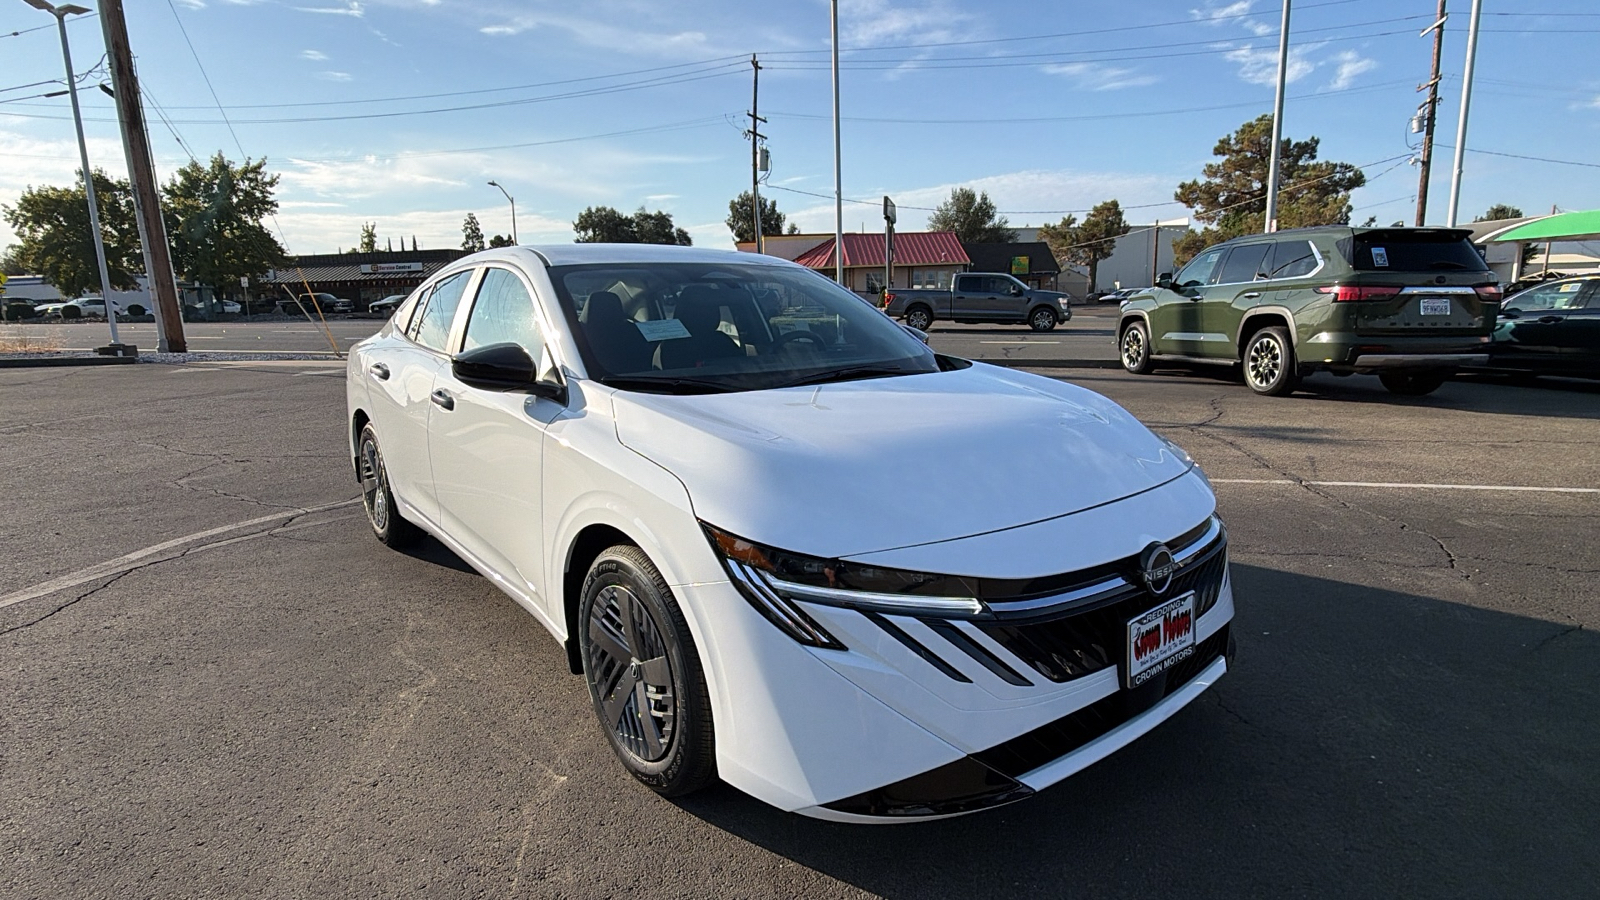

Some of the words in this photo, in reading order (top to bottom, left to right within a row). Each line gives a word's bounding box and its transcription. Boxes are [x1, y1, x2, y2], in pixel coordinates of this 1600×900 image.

[1146, 600, 1181, 622] REDDING
[1162, 608, 1192, 646] Motors
[1135, 660, 1163, 685] CROWN
[1163, 646, 1193, 668] MOTORS
